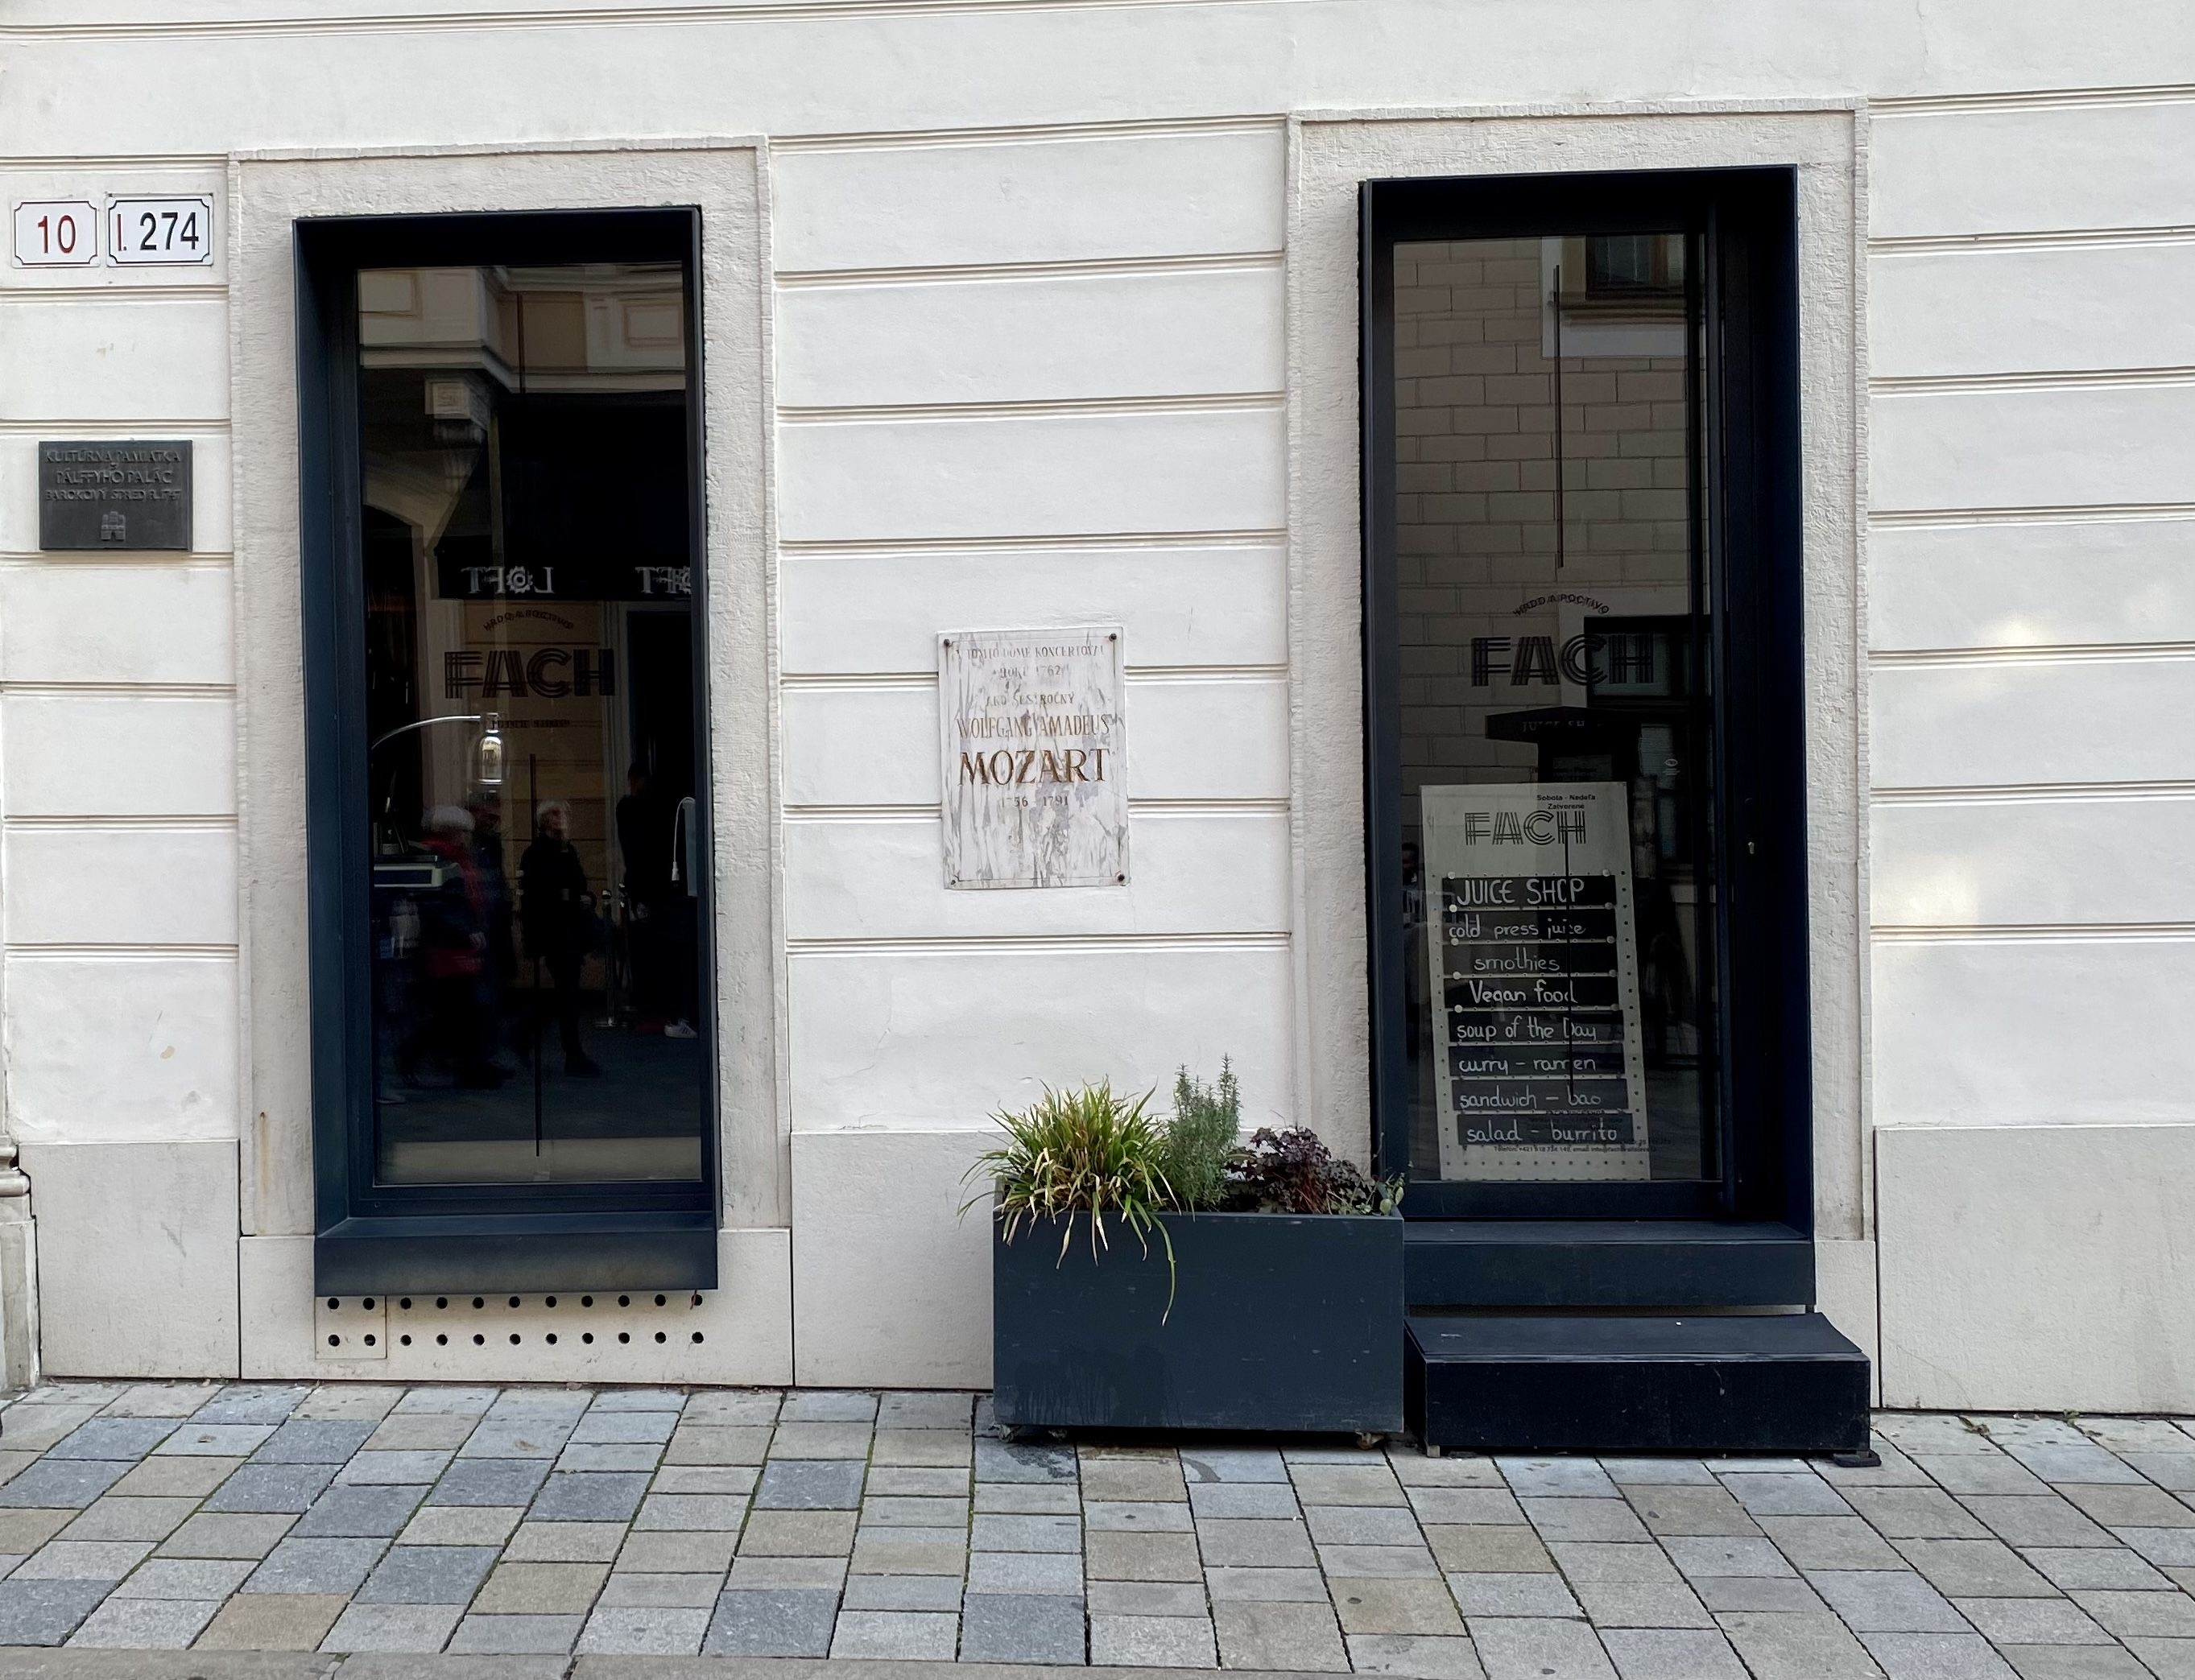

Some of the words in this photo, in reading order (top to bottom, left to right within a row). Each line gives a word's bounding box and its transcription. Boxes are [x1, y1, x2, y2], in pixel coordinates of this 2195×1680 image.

[37, 214, 76, 254] 10
[139, 212, 200, 251] 274
[127, 468, 173, 484] PALÁC
[1470, 633, 1654, 687] FACH
[444, 647, 616, 700] FACH
[957, 716, 1033, 739] WOLFGANG
[1038, 713, 1110, 737] AMADEUS
[958, 748, 1110, 786] MOZART
[1043, 795, 1069, 807] 1791
[1465, 810, 1587, 846] FACH
[1456, 878, 1516, 906] JUICE
[1449, 914, 1482, 939] cold
[1494, 924, 1540, 939] press
[1474, 946, 1560, 972] smothies
[1469, 979, 1527, 1004] Vegan
[1533, 979, 1578, 1004] food
[1457, 1023, 1497, 1042] soup
[1505, 1015, 1522, 1038] of
[1526, 1016, 1555, 1039] the
[1458, 1059, 1509, 1075] curry
[1533, 1058, 1596, 1071] ramen
[1459, 1084, 1537, 1109] sandwich
[1567, 1084, 1602, 1106] bao
[1466, 1119, 1523, 1142] salad
[1550, 1117, 1618, 1141] burrito
